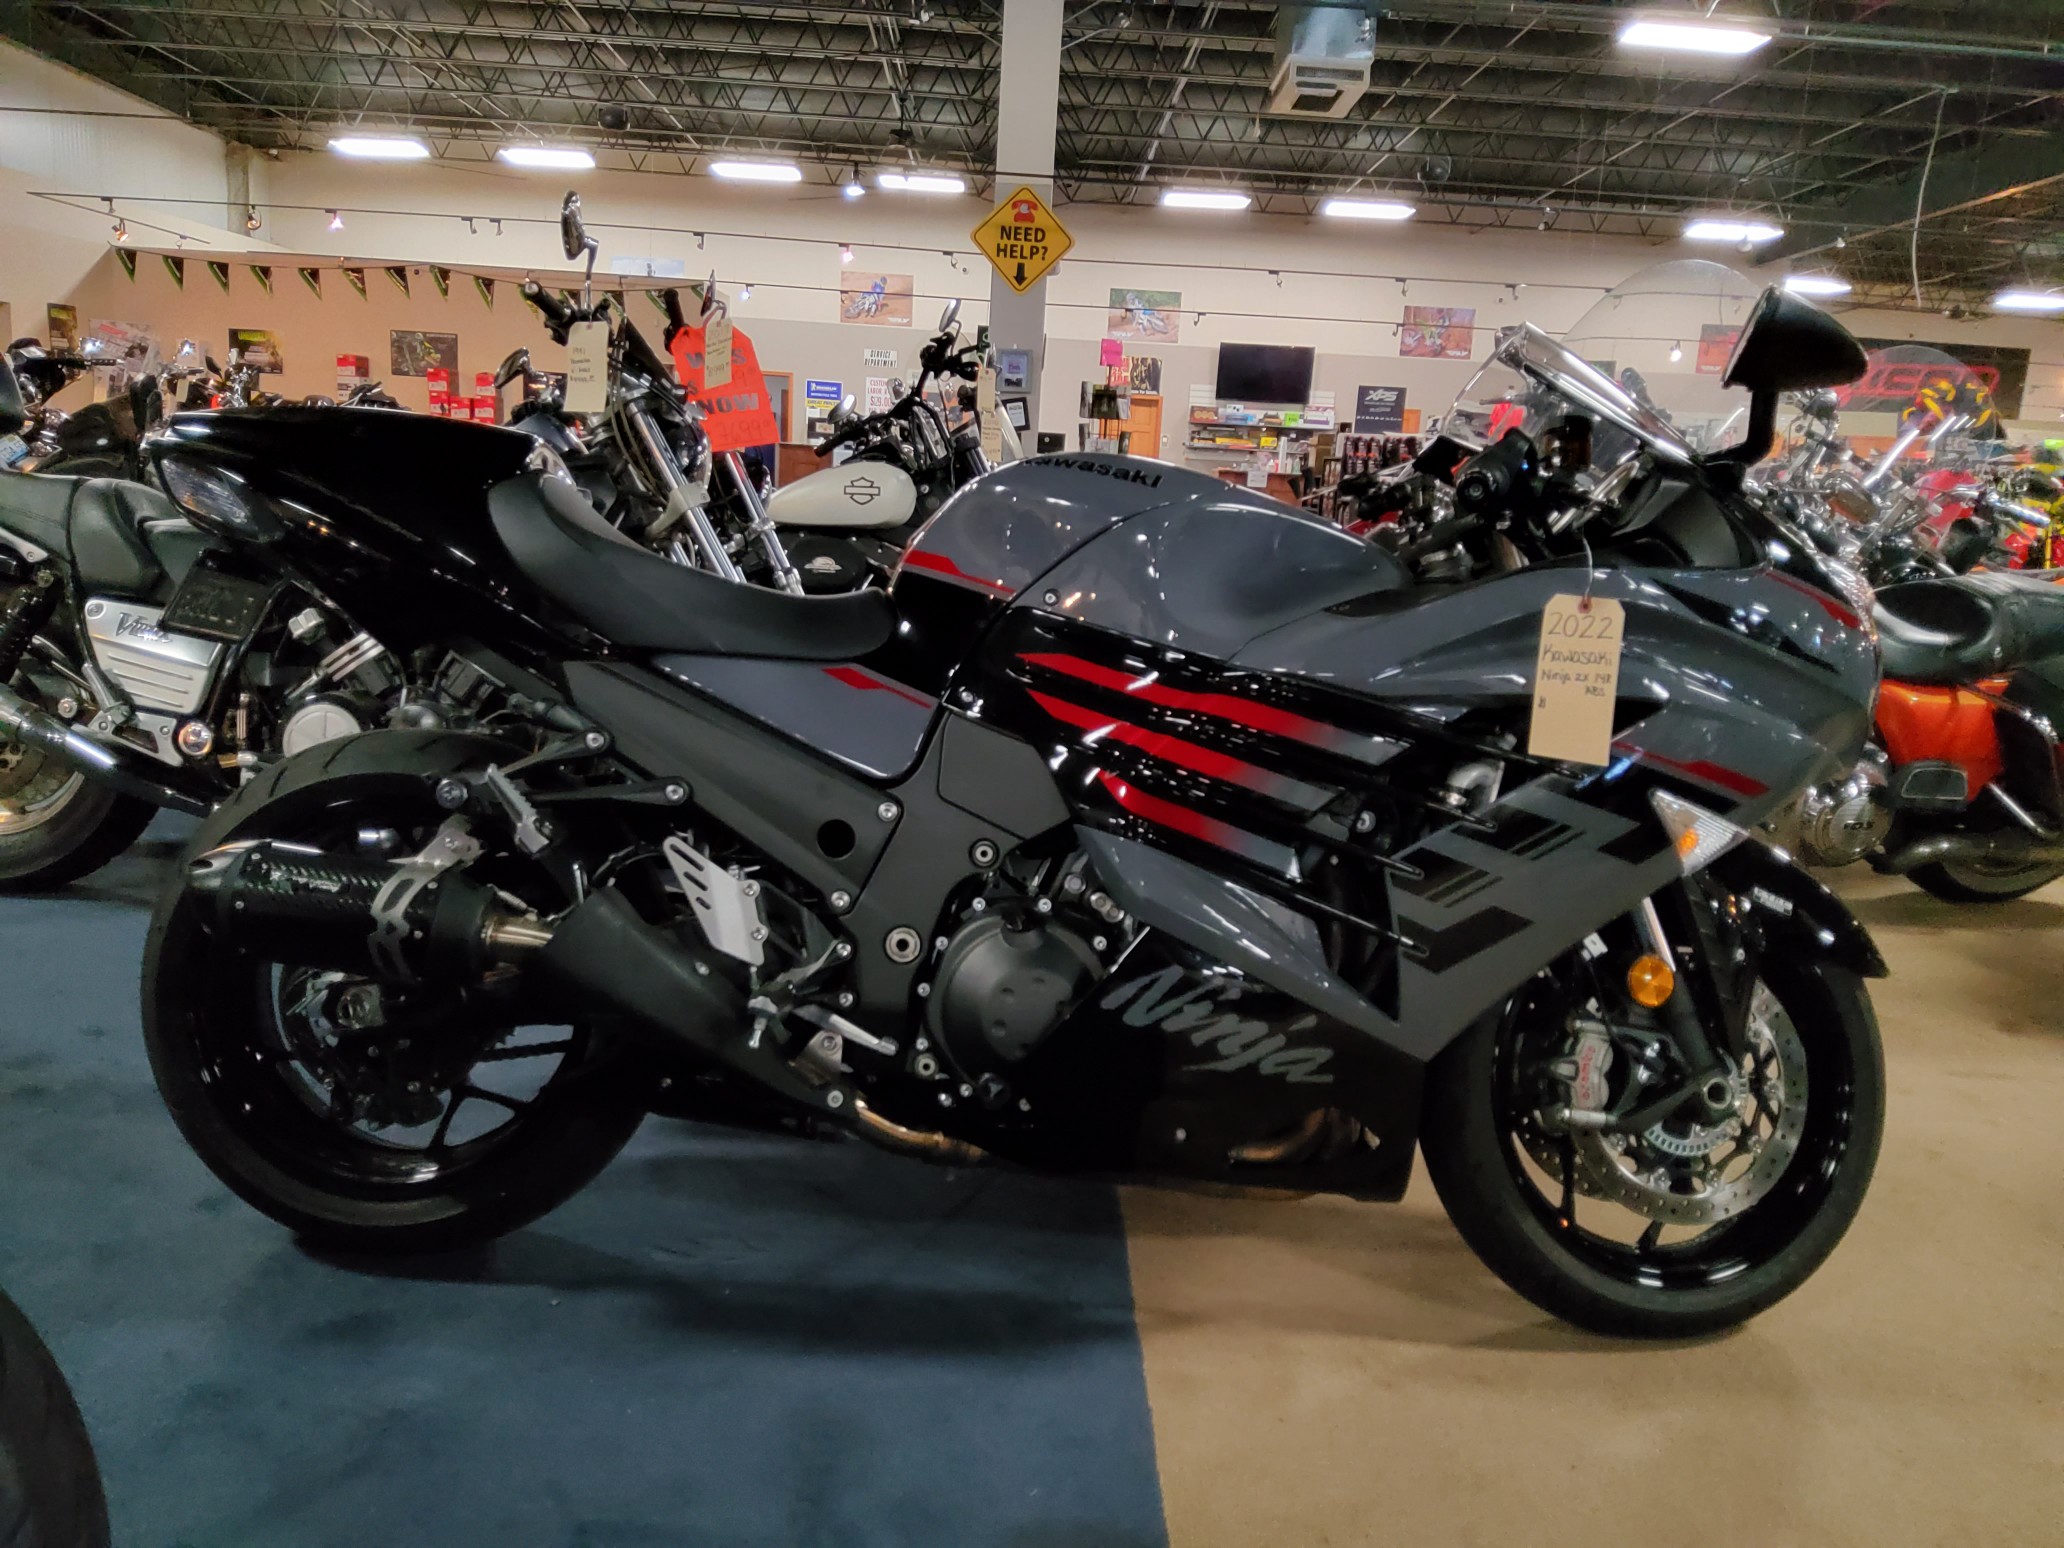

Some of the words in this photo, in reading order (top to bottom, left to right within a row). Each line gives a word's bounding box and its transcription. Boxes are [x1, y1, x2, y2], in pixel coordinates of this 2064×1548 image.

[1000, 225, 1046, 243] NEED
[996, 243, 1048, 261] HELP?
[685, 348, 747, 369] WS
[865, 358, 897, 368] DEPARTMENT
[870, 349, 891, 359] SERVICE
[698, 393, 759, 414] NOW
[1548, 611, 1614, 639] 2022
[1542, 644, 1612, 667] Kawasaki
[1541, 669, 1571, 685] Ninja
[1100, 964, 1335, 1083] Ninja
